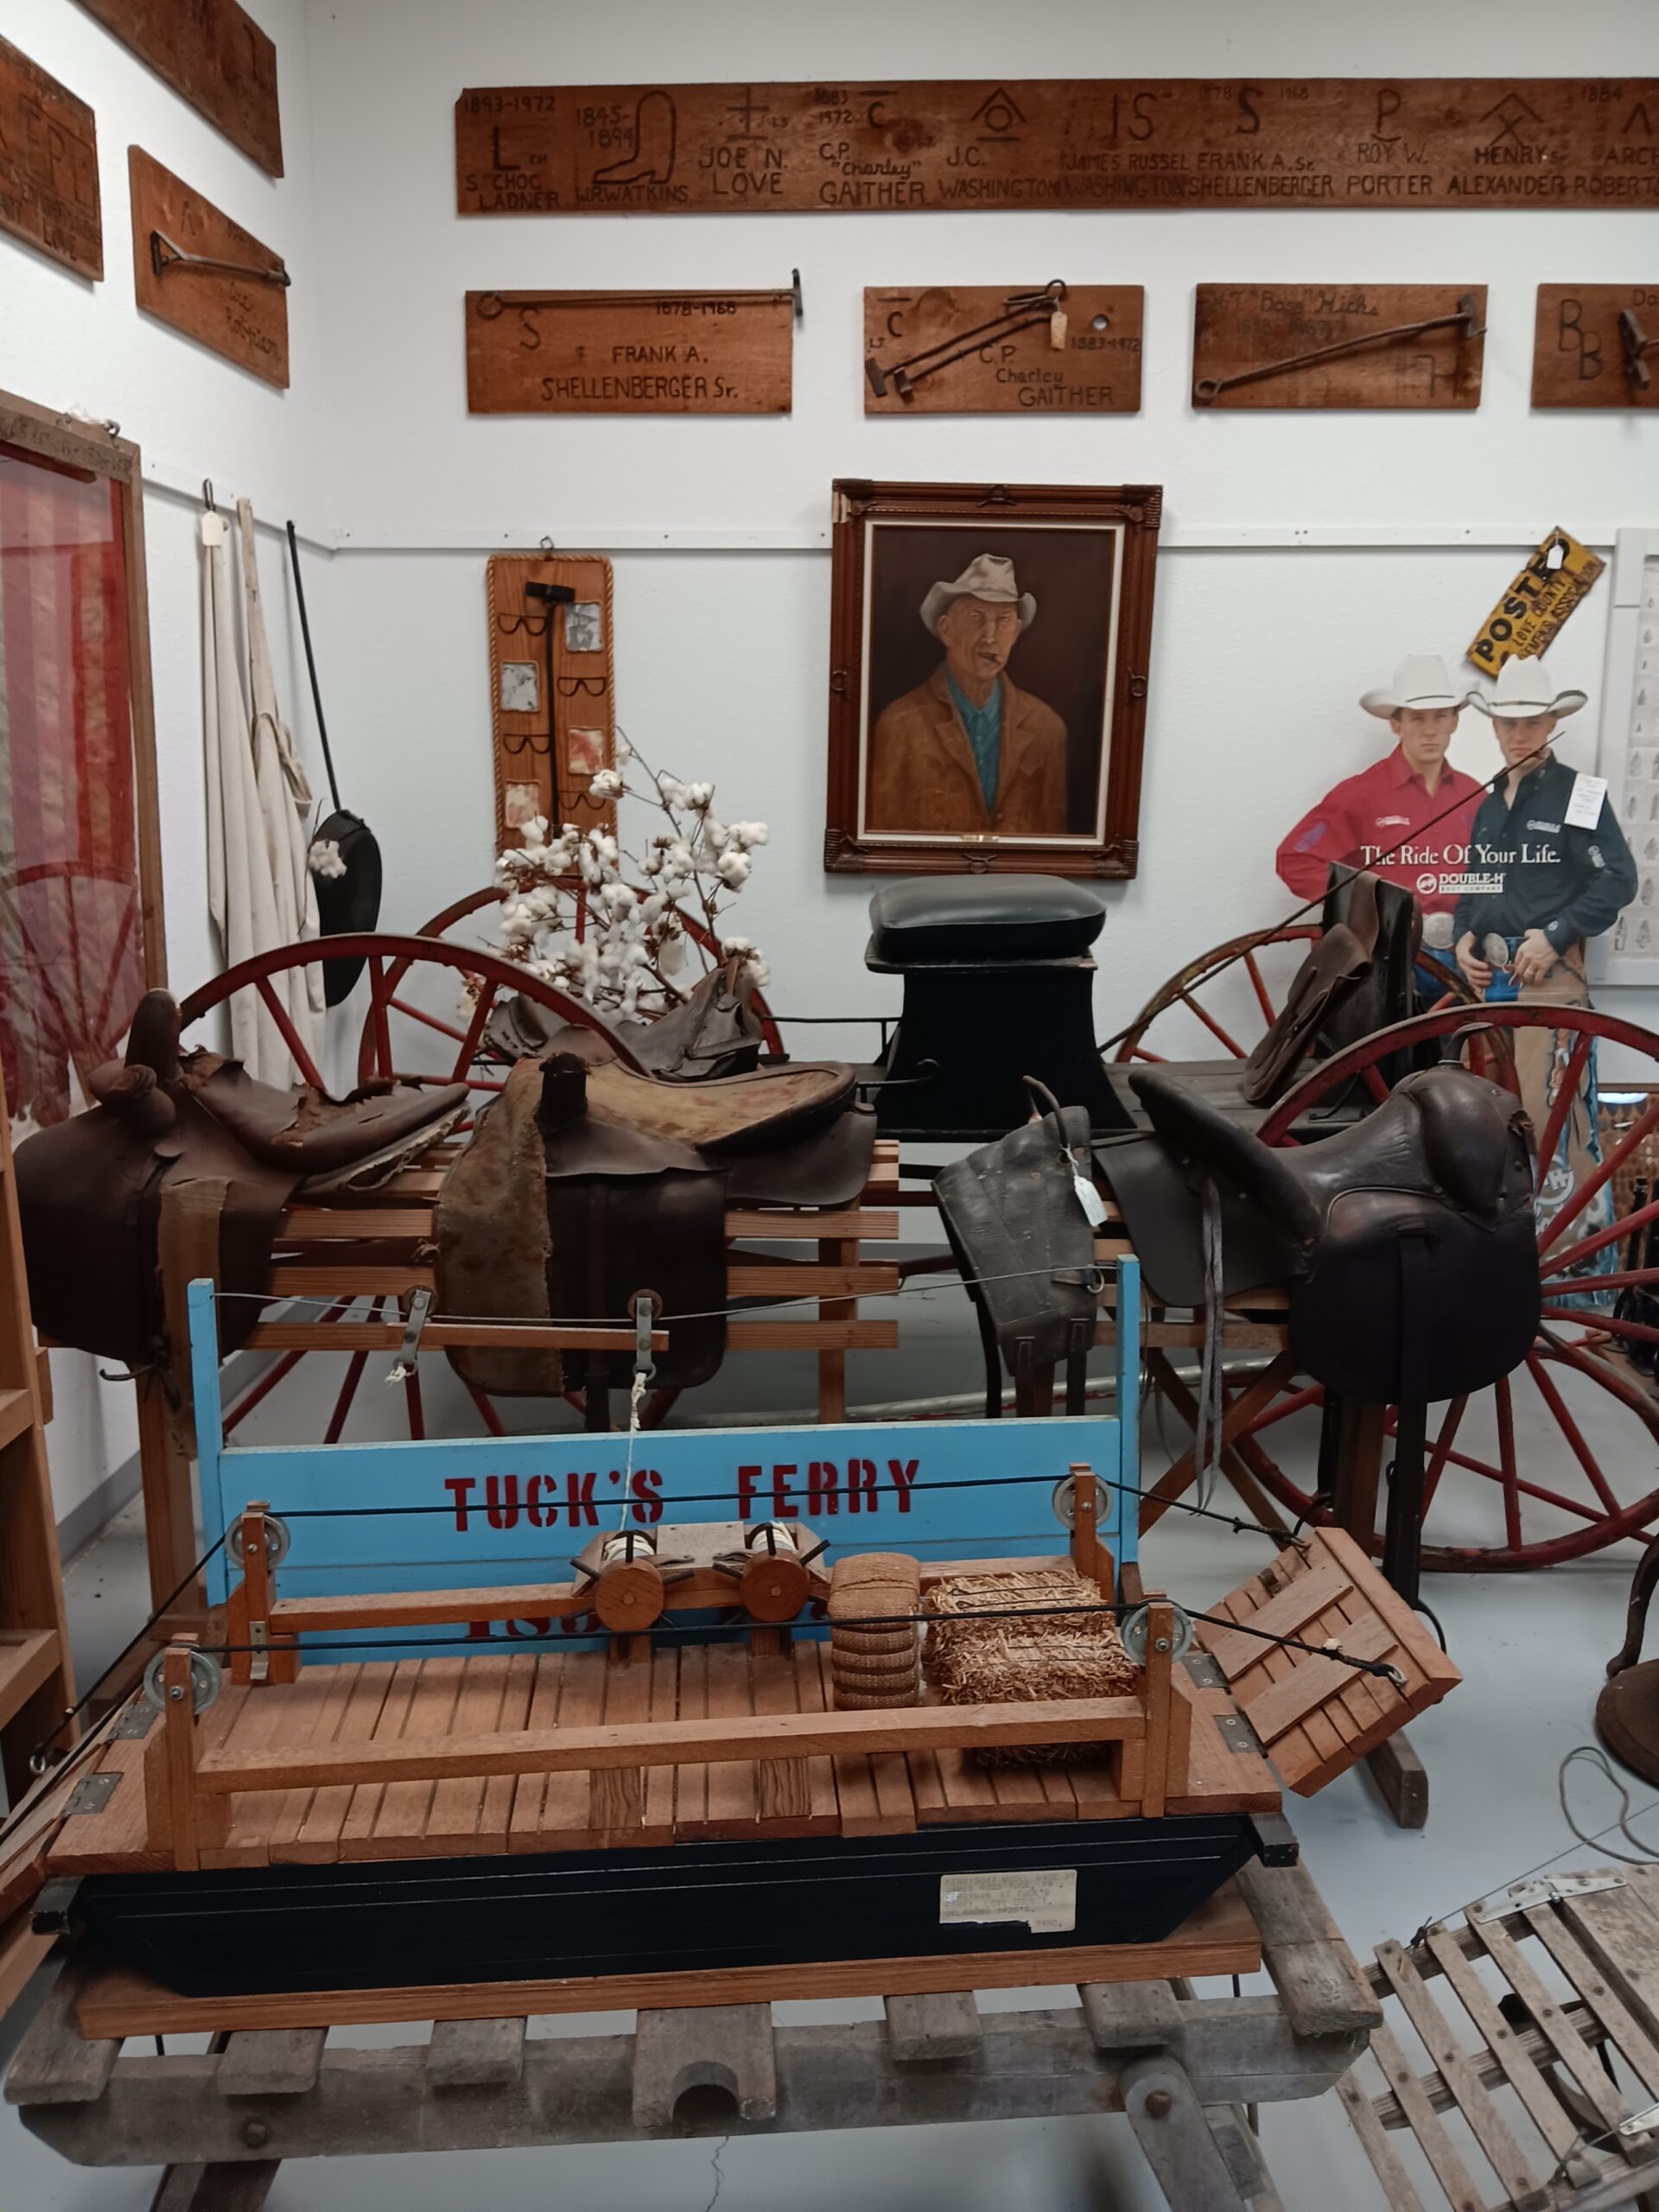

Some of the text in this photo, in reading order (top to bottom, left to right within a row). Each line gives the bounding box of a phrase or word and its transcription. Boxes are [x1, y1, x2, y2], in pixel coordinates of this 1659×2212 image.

[493, 124, 521, 170] L
[698, 146, 788, 169] JOE N.
[946, 145, 986, 168] J.C.
[1357, 143, 1395, 165] ROY
[1474, 145, 1548, 166] HENRY
[1128, 152, 1190, 172] RUSSEL
[1197, 152, 1265, 172] FRANK
[712, 171, 784, 195] LOVE
[819, 181, 925, 206] GAITHER
[938, 177, 1060, 200] WASHINGTON
[1188, 175, 1335, 199] SHELLENBERGER
[1346, 175, 1433, 197] PORTER
[1446, 175, 1567, 197] ALEXANDER
[478, 191, 560, 211] LADNER
[612, 346, 709, 365] FRANK A.
[541, 376, 709, 401] SHELLENBERGER
[1017, 385, 1114, 408] GAITHER
[1401, 843, 1440, 864] Ride
[1443, 843, 1471, 864] Of
[1475, 843, 1517, 864] Your
[444, 1459, 920, 1532] TUCK'S FERRY
